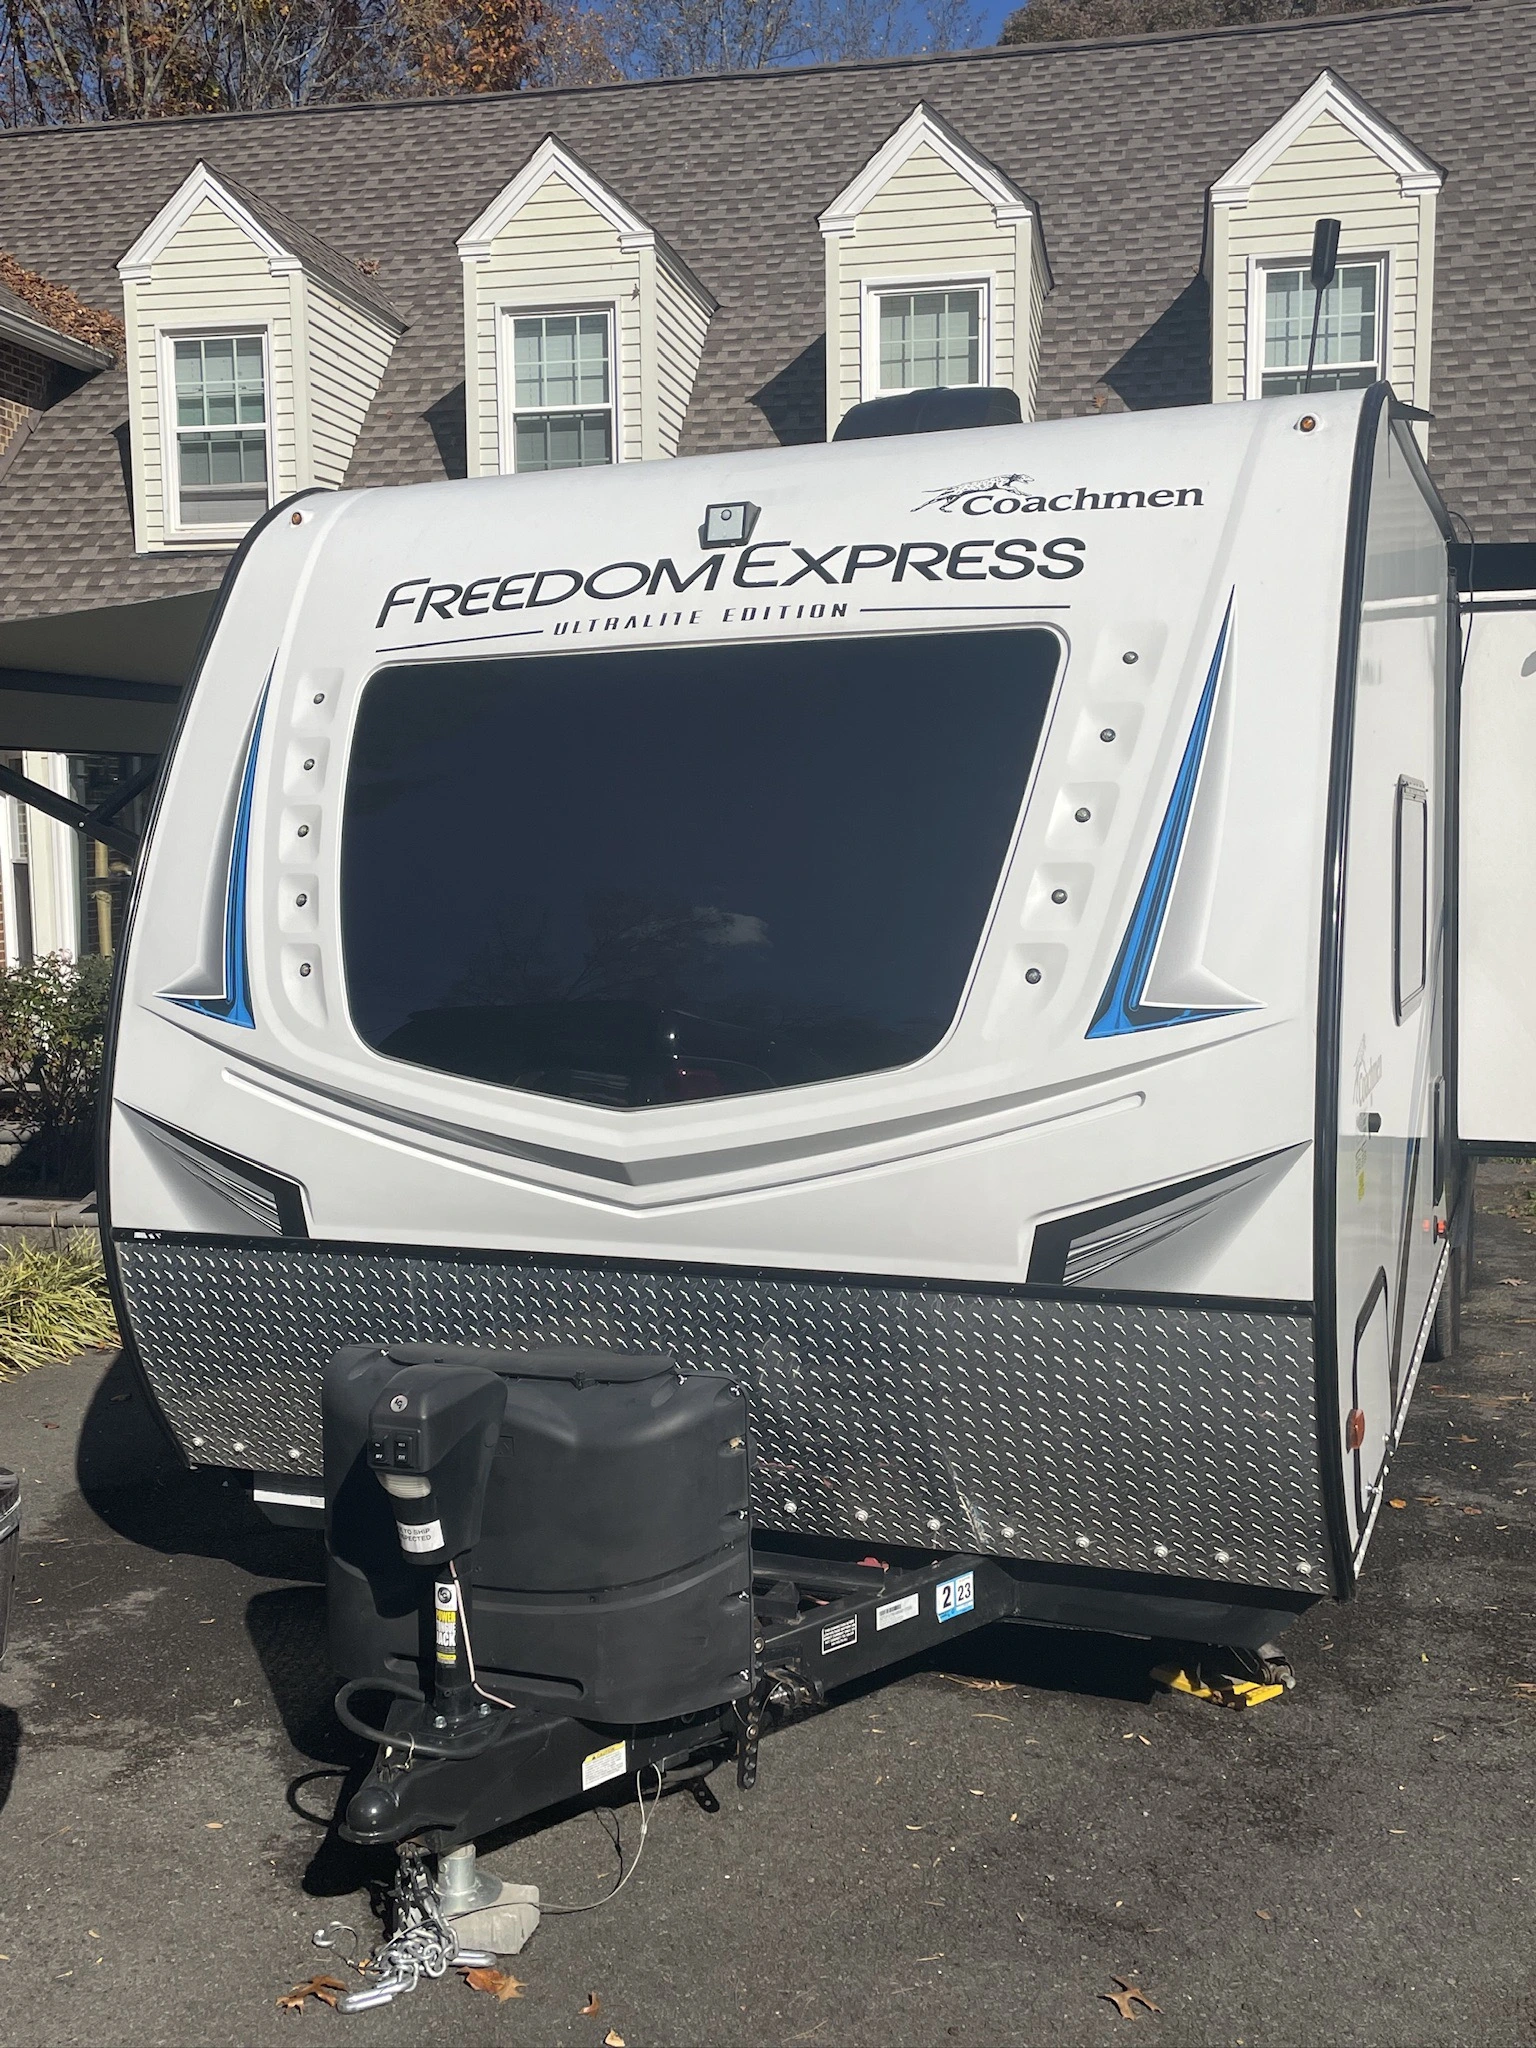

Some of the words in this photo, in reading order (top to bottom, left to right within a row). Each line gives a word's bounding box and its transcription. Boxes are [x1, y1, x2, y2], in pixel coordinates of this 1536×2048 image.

[961, 486, 1204, 515] Coachmen
[375, 554, 725, 628] FREEDOM
[733, 538, 1086, 588] EXPRESS
[553, 609, 703, 636] ULTRALITE
[722, 602, 848, 623] EDITION
[942, 1585, 952, 1609] 2
[958, 1582, 971, 1601] 23
